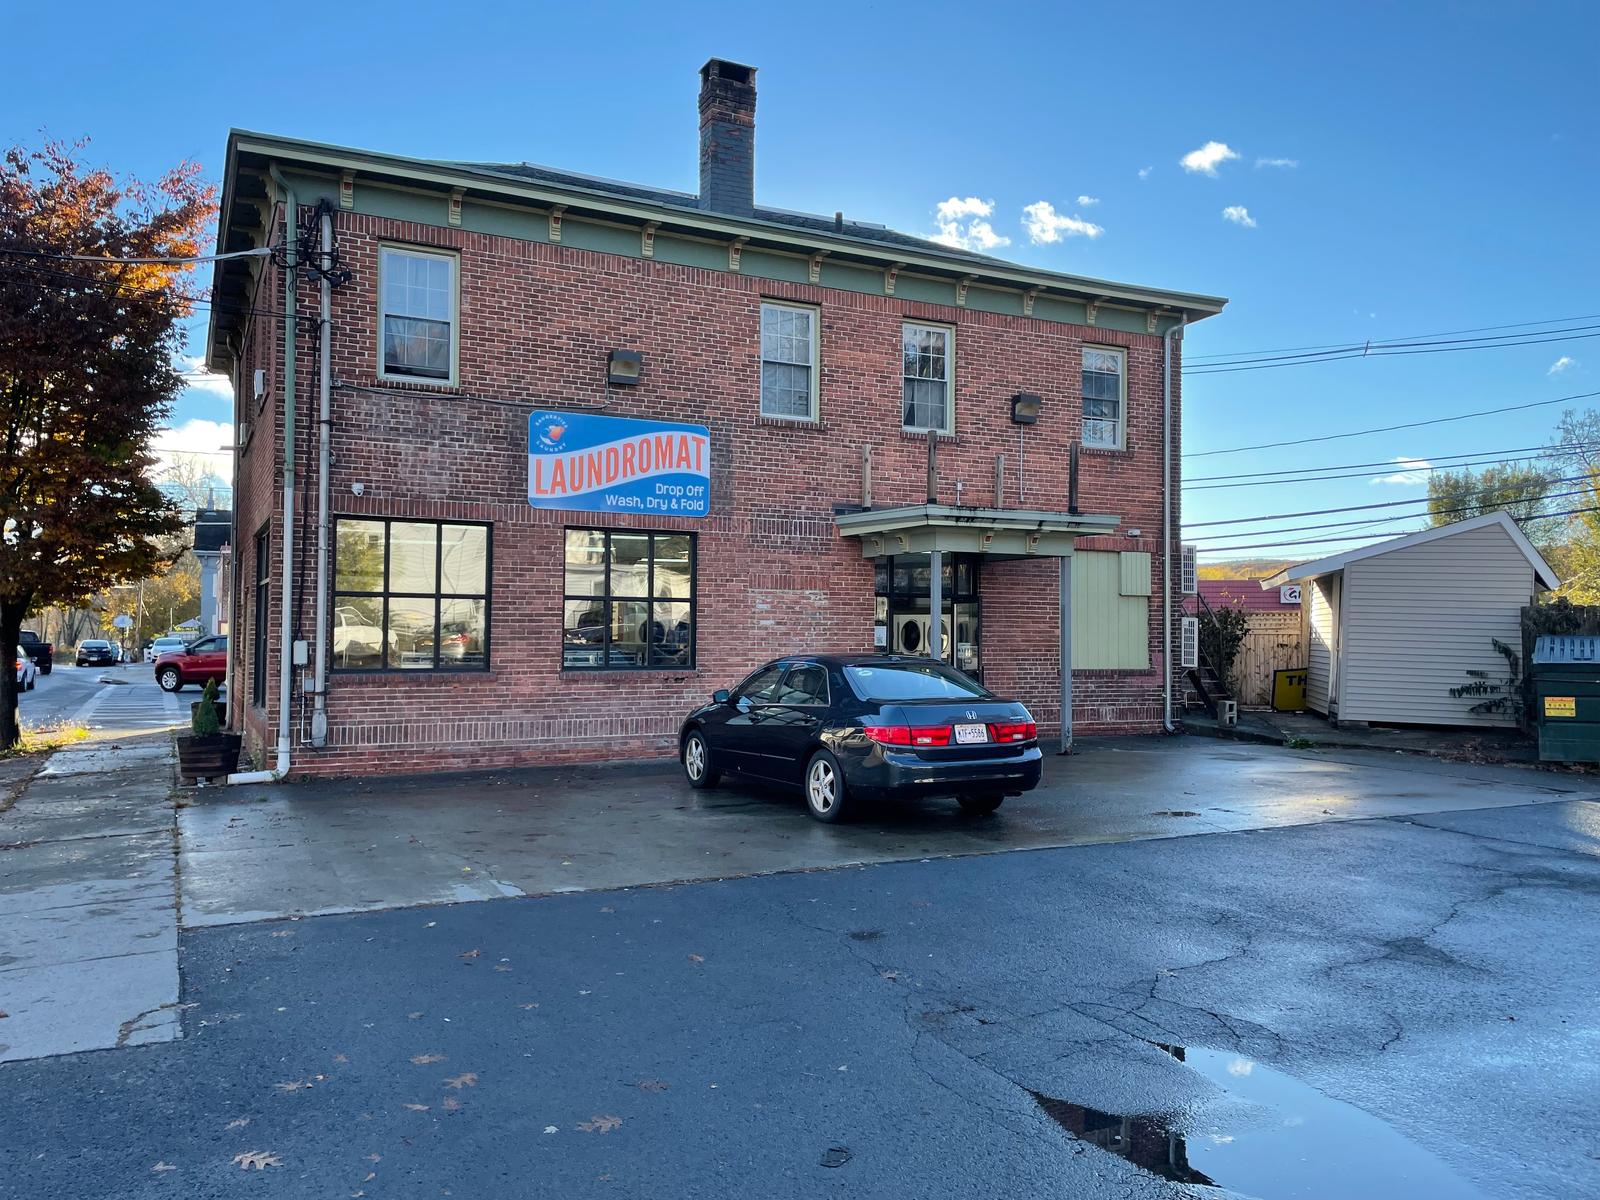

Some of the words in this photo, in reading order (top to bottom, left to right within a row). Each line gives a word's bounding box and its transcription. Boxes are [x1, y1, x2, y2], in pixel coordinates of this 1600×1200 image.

[536, 440, 566, 452] LAUNDRY
[535, 435, 705, 495] LAUNDROMAT
[655, 483, 684, 497] Drop
[686, 485, 705, 497] Off
[605, 495, 644, 509] Wash,
[646, 496, 668, 510] Dry
[670, 498, 679, 510] &
[680, 498, 704, 511] Fold
